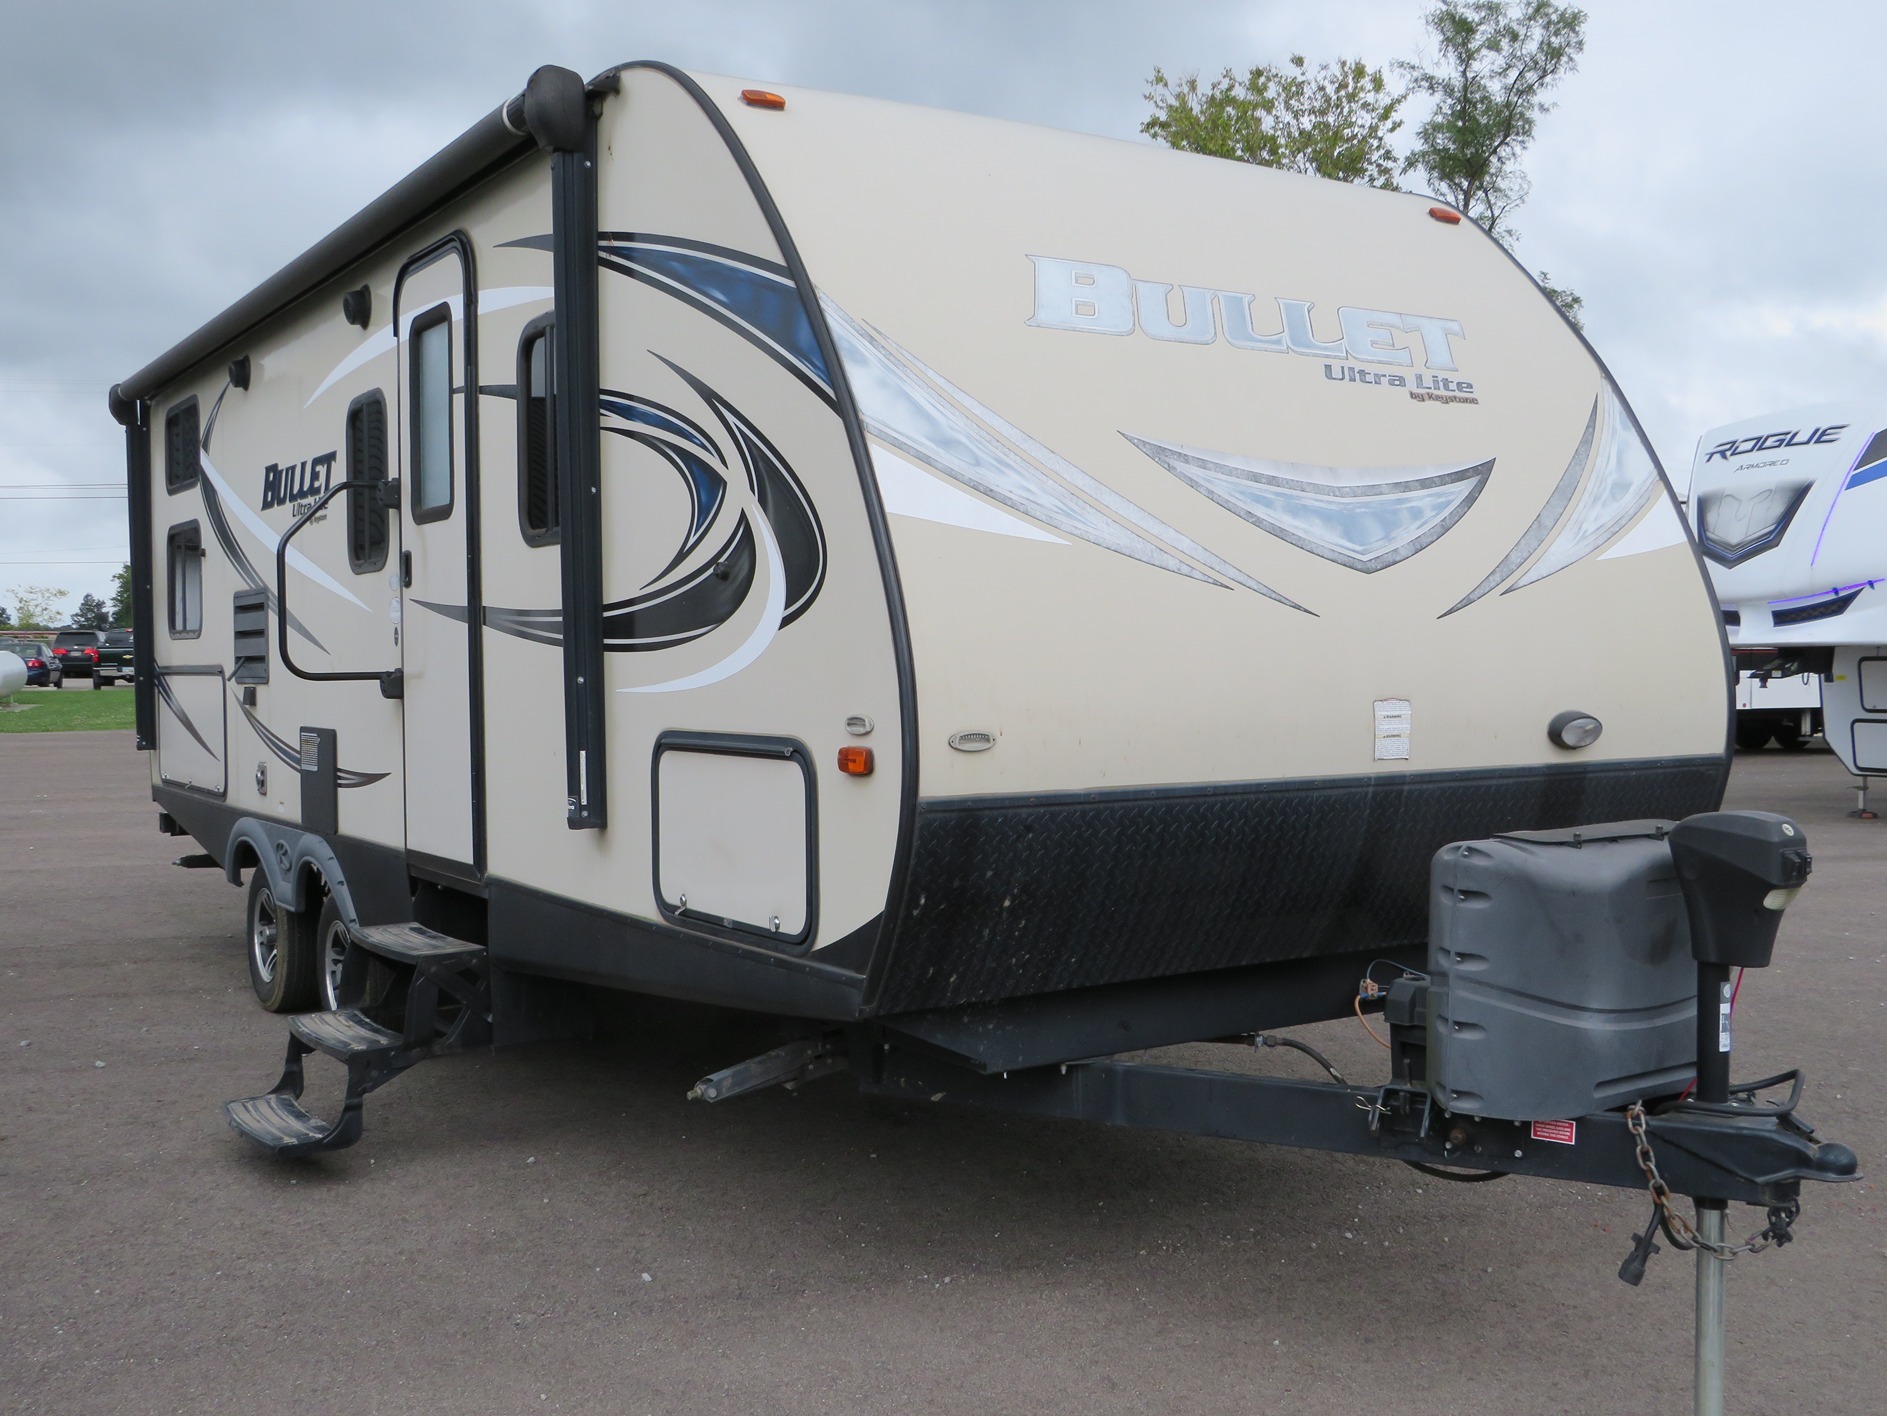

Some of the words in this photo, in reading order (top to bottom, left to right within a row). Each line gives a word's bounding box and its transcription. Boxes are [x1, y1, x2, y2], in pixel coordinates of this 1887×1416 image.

[1024, 254, 1466, 372] BULLET
[1324, 364, 1406, 388] Ultra
[1415, 373, 1474, 394] Lite
[1408, 390, 1425, 403] by
[1427, 392, 1479, 405] Keystone
[1705, 424, 1851, 463] ROGUE
[261, 450, 337, 511] BULLET
[1734, 459, 1790, 473] ARMORED
